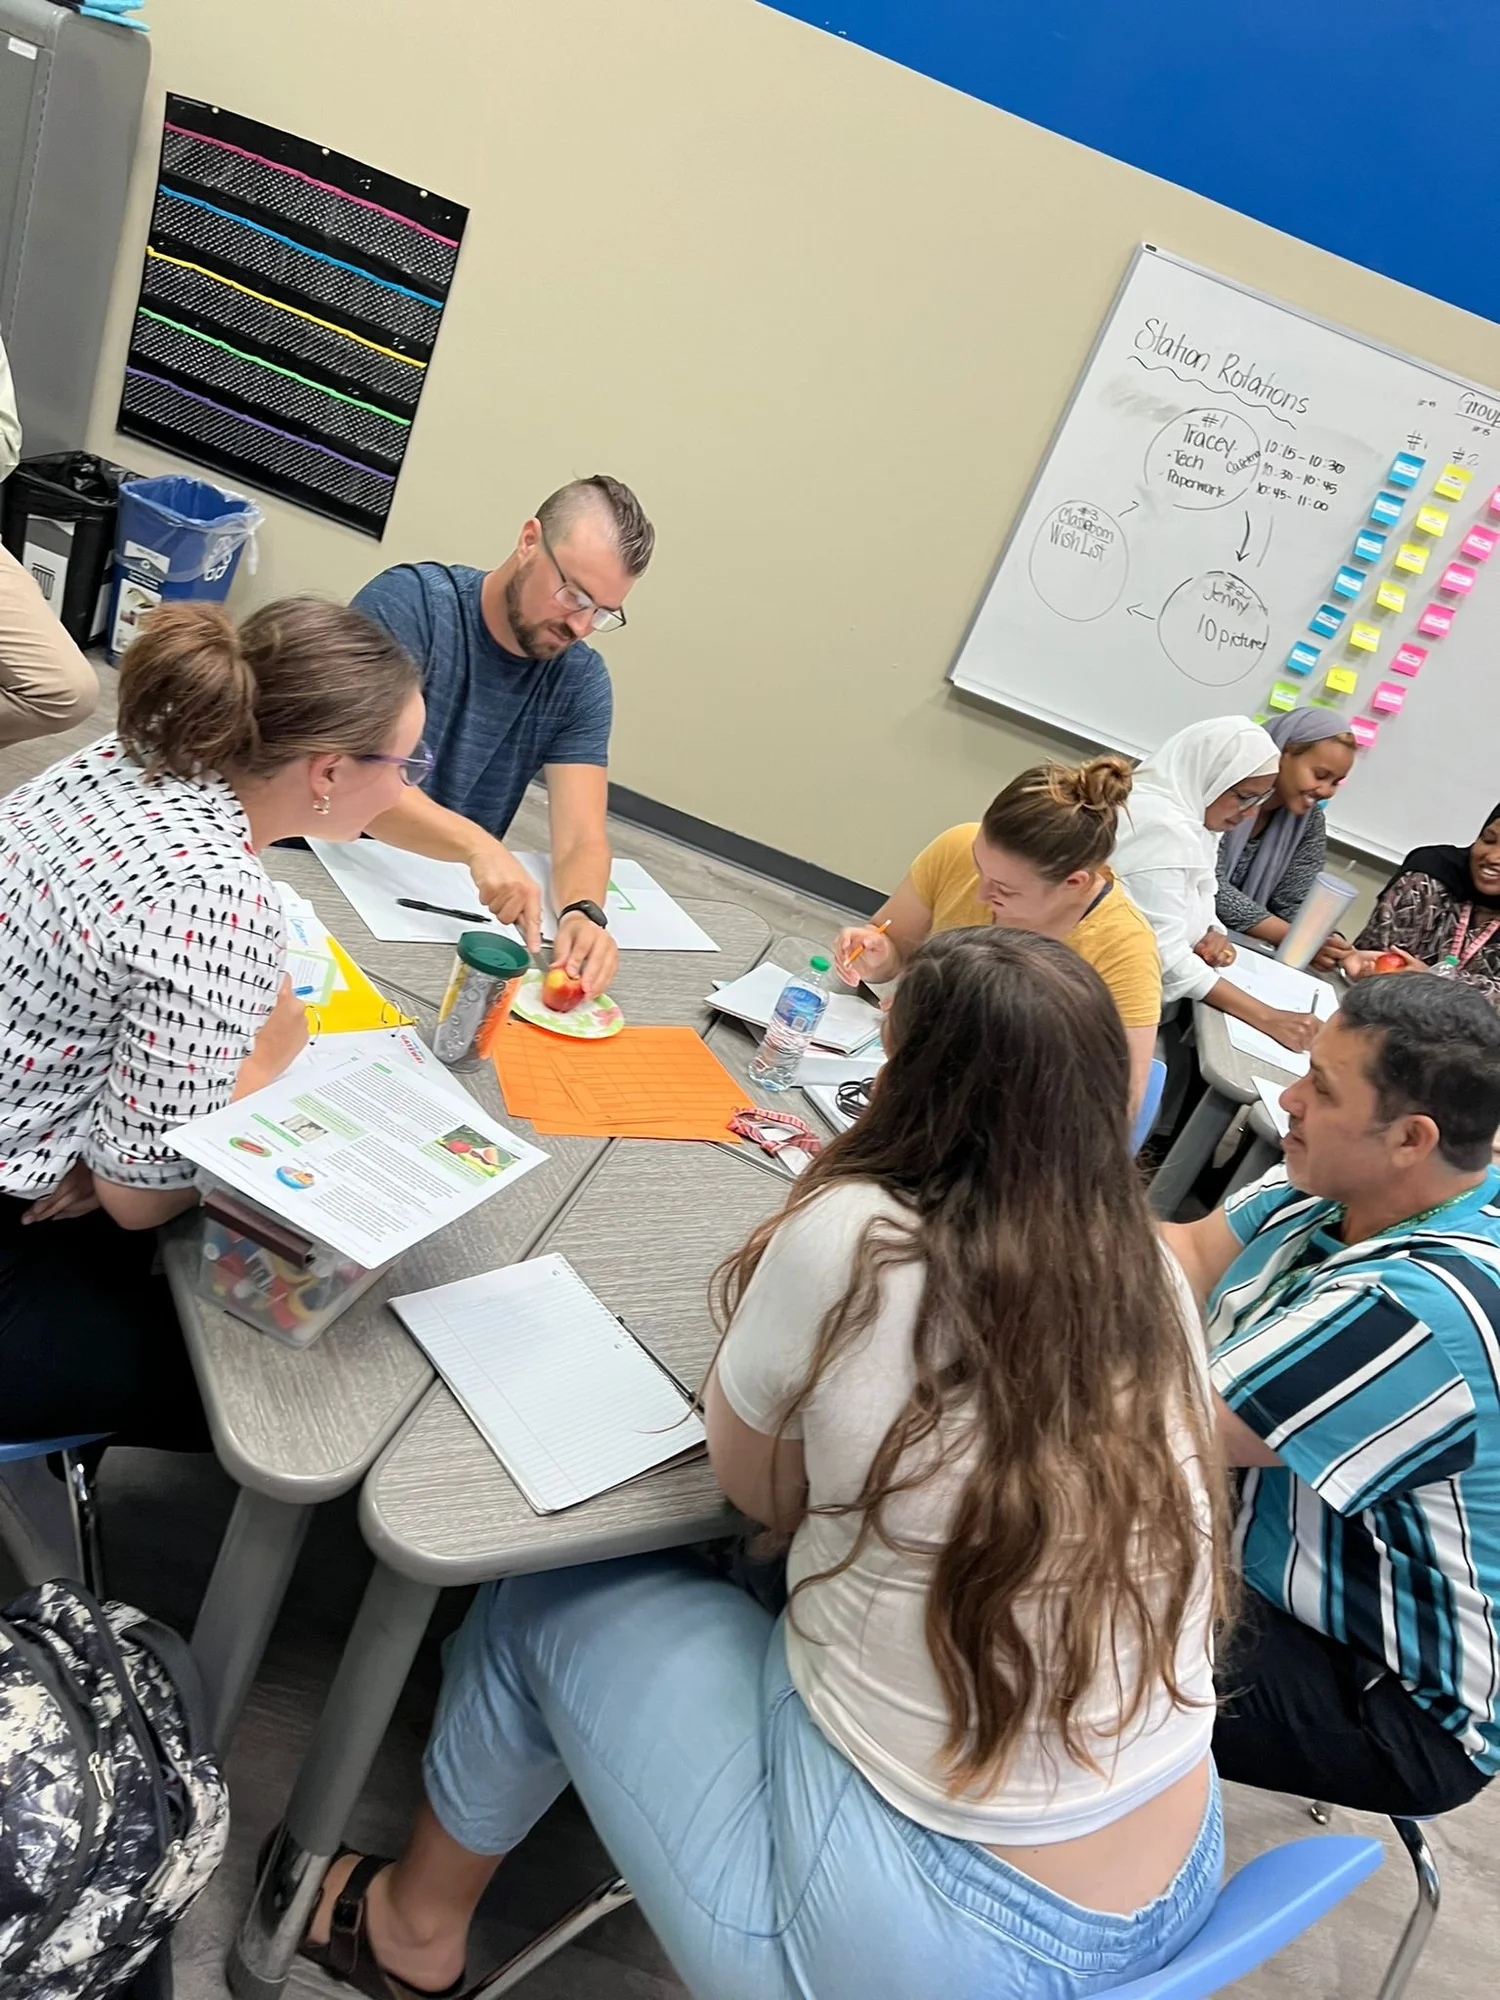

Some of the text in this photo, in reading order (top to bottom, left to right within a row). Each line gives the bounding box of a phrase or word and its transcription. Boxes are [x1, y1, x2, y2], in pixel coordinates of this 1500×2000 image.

[1134, 318, 1310, 414] Station Rotations
[1201, 412, 1229, 429] #1
[1183, 423, 1237, 459] Tracey
[1173, 449, 1205, 470] Tech
[1167, 468, 1226, 498] Paperwork
[1050, 521, 1107, 563] Wish List
[1202, 581, 1251, 617] Jenny
